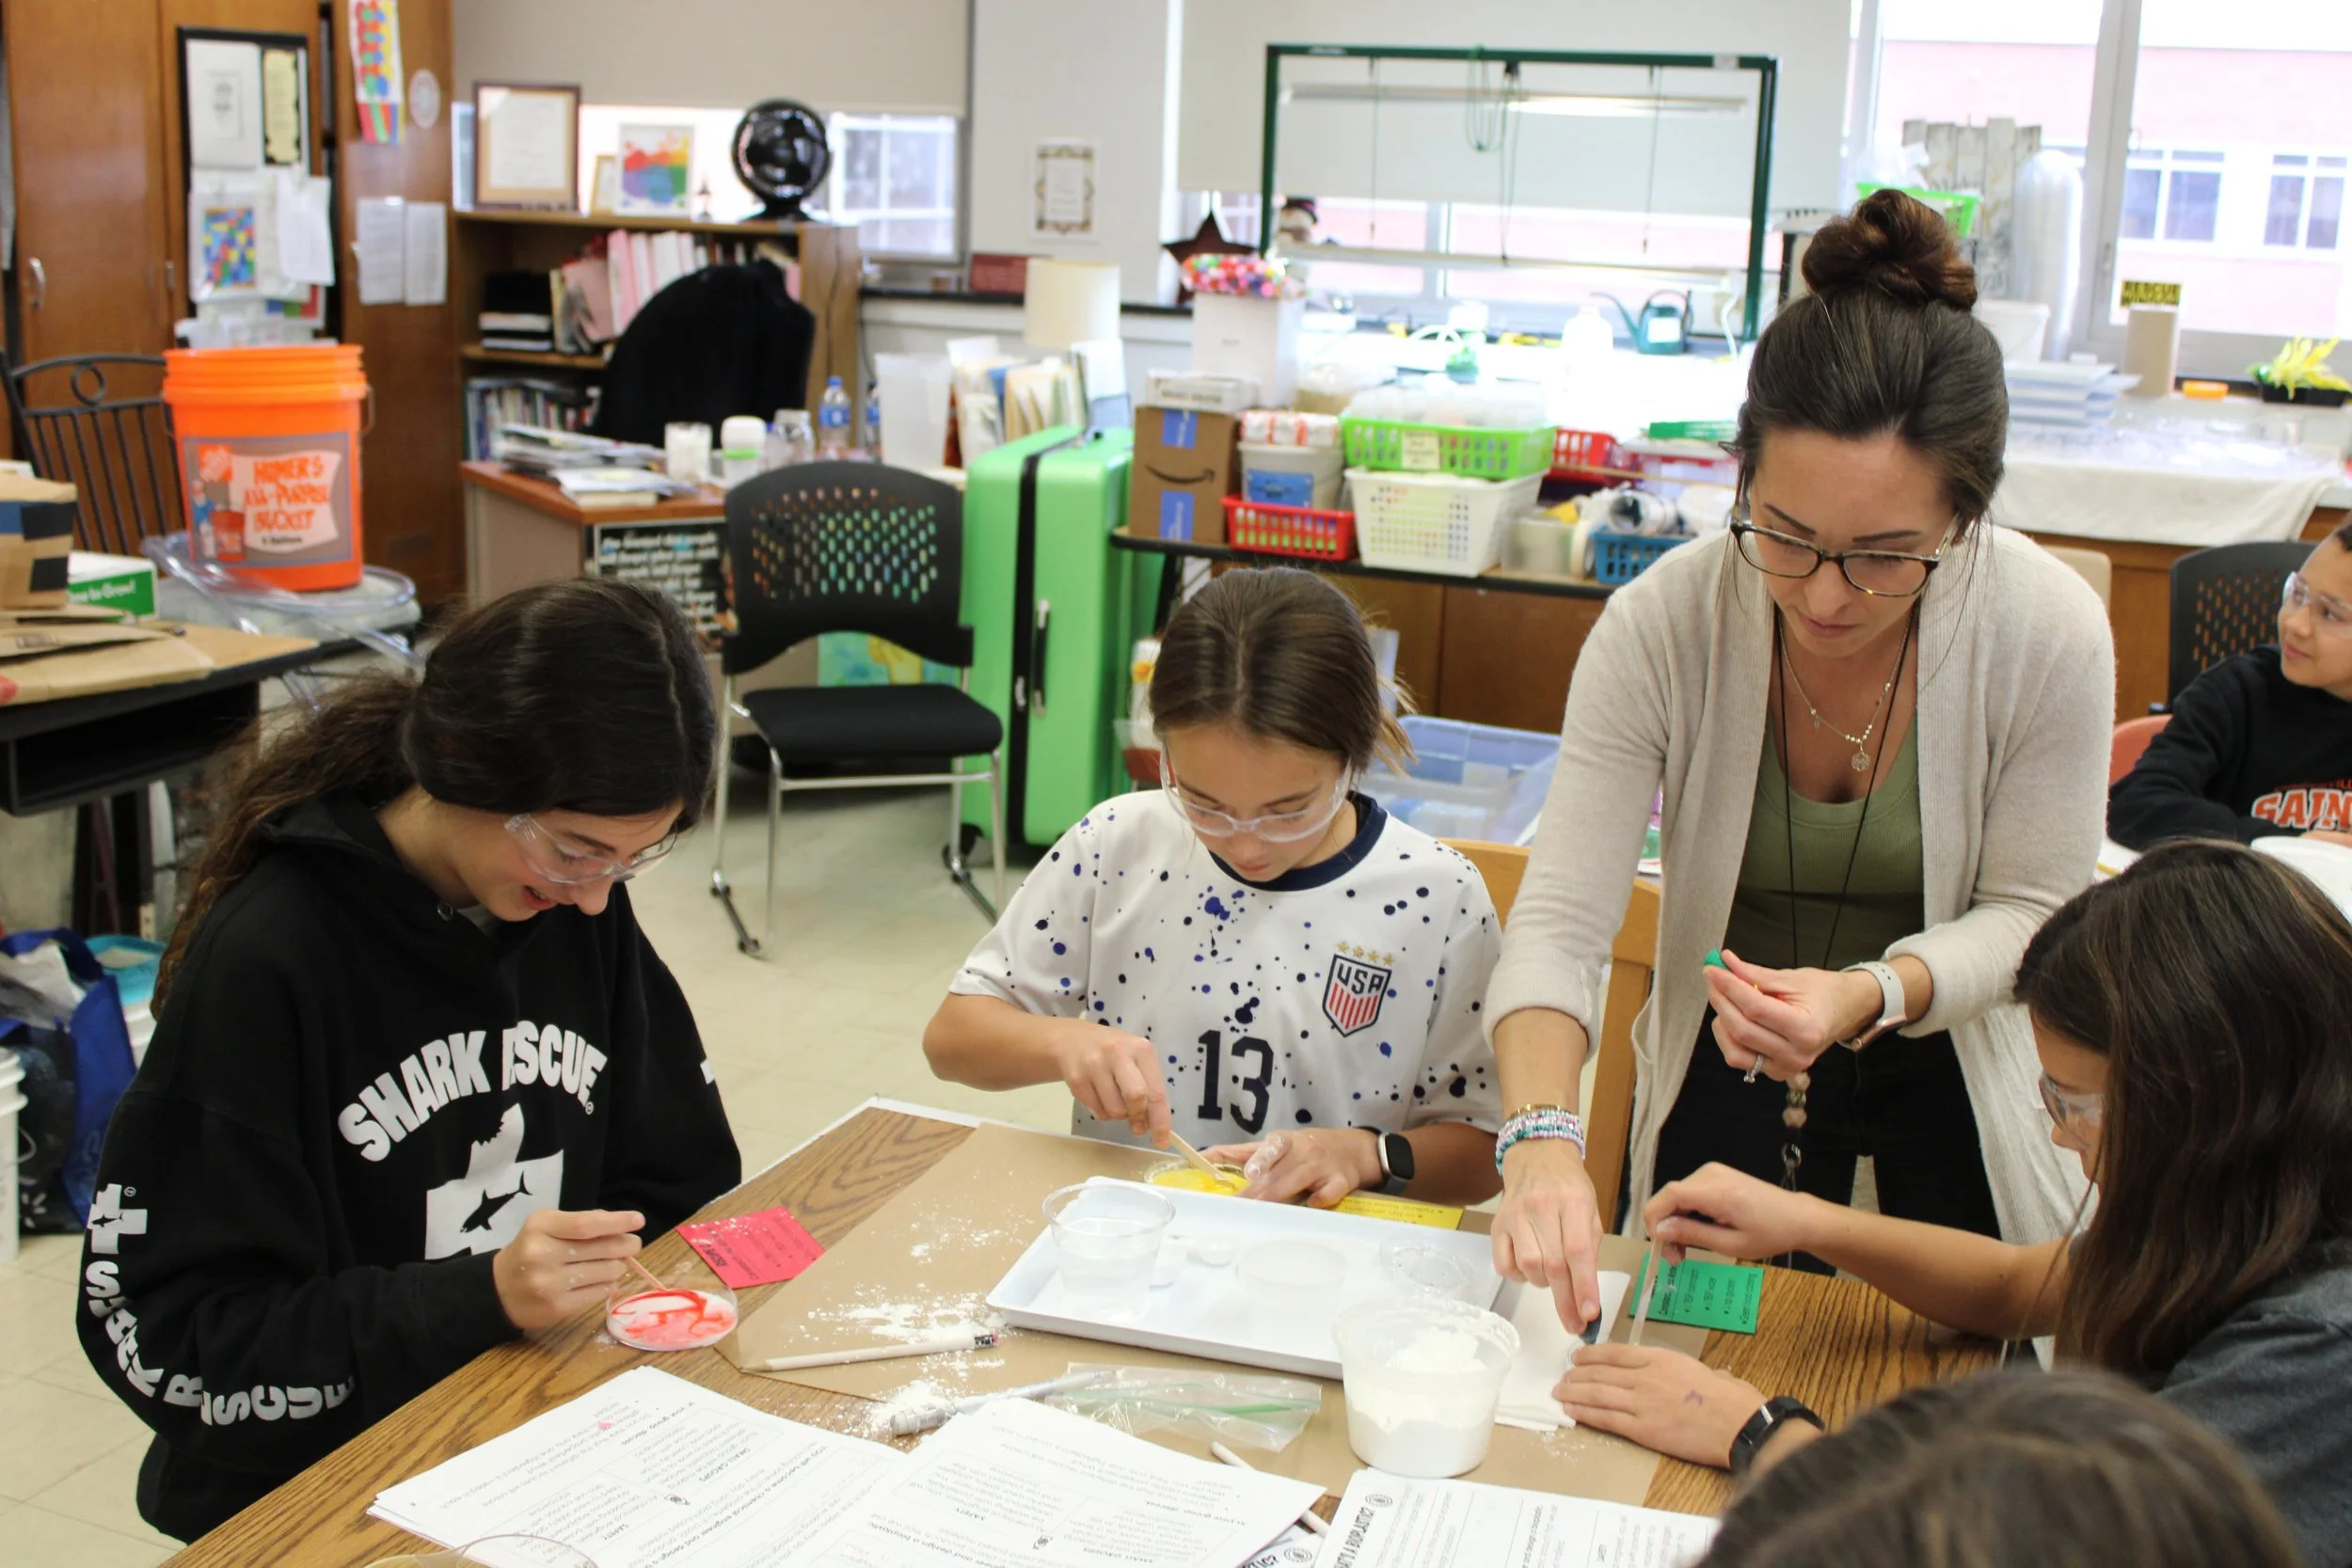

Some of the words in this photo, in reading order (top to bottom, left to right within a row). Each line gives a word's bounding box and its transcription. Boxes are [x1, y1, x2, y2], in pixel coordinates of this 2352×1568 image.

[1337, 963, 1384, 994] USA
[338, 1030, 491, 1162] SHARK
[1198, 1029, 1274, 1134] 13
